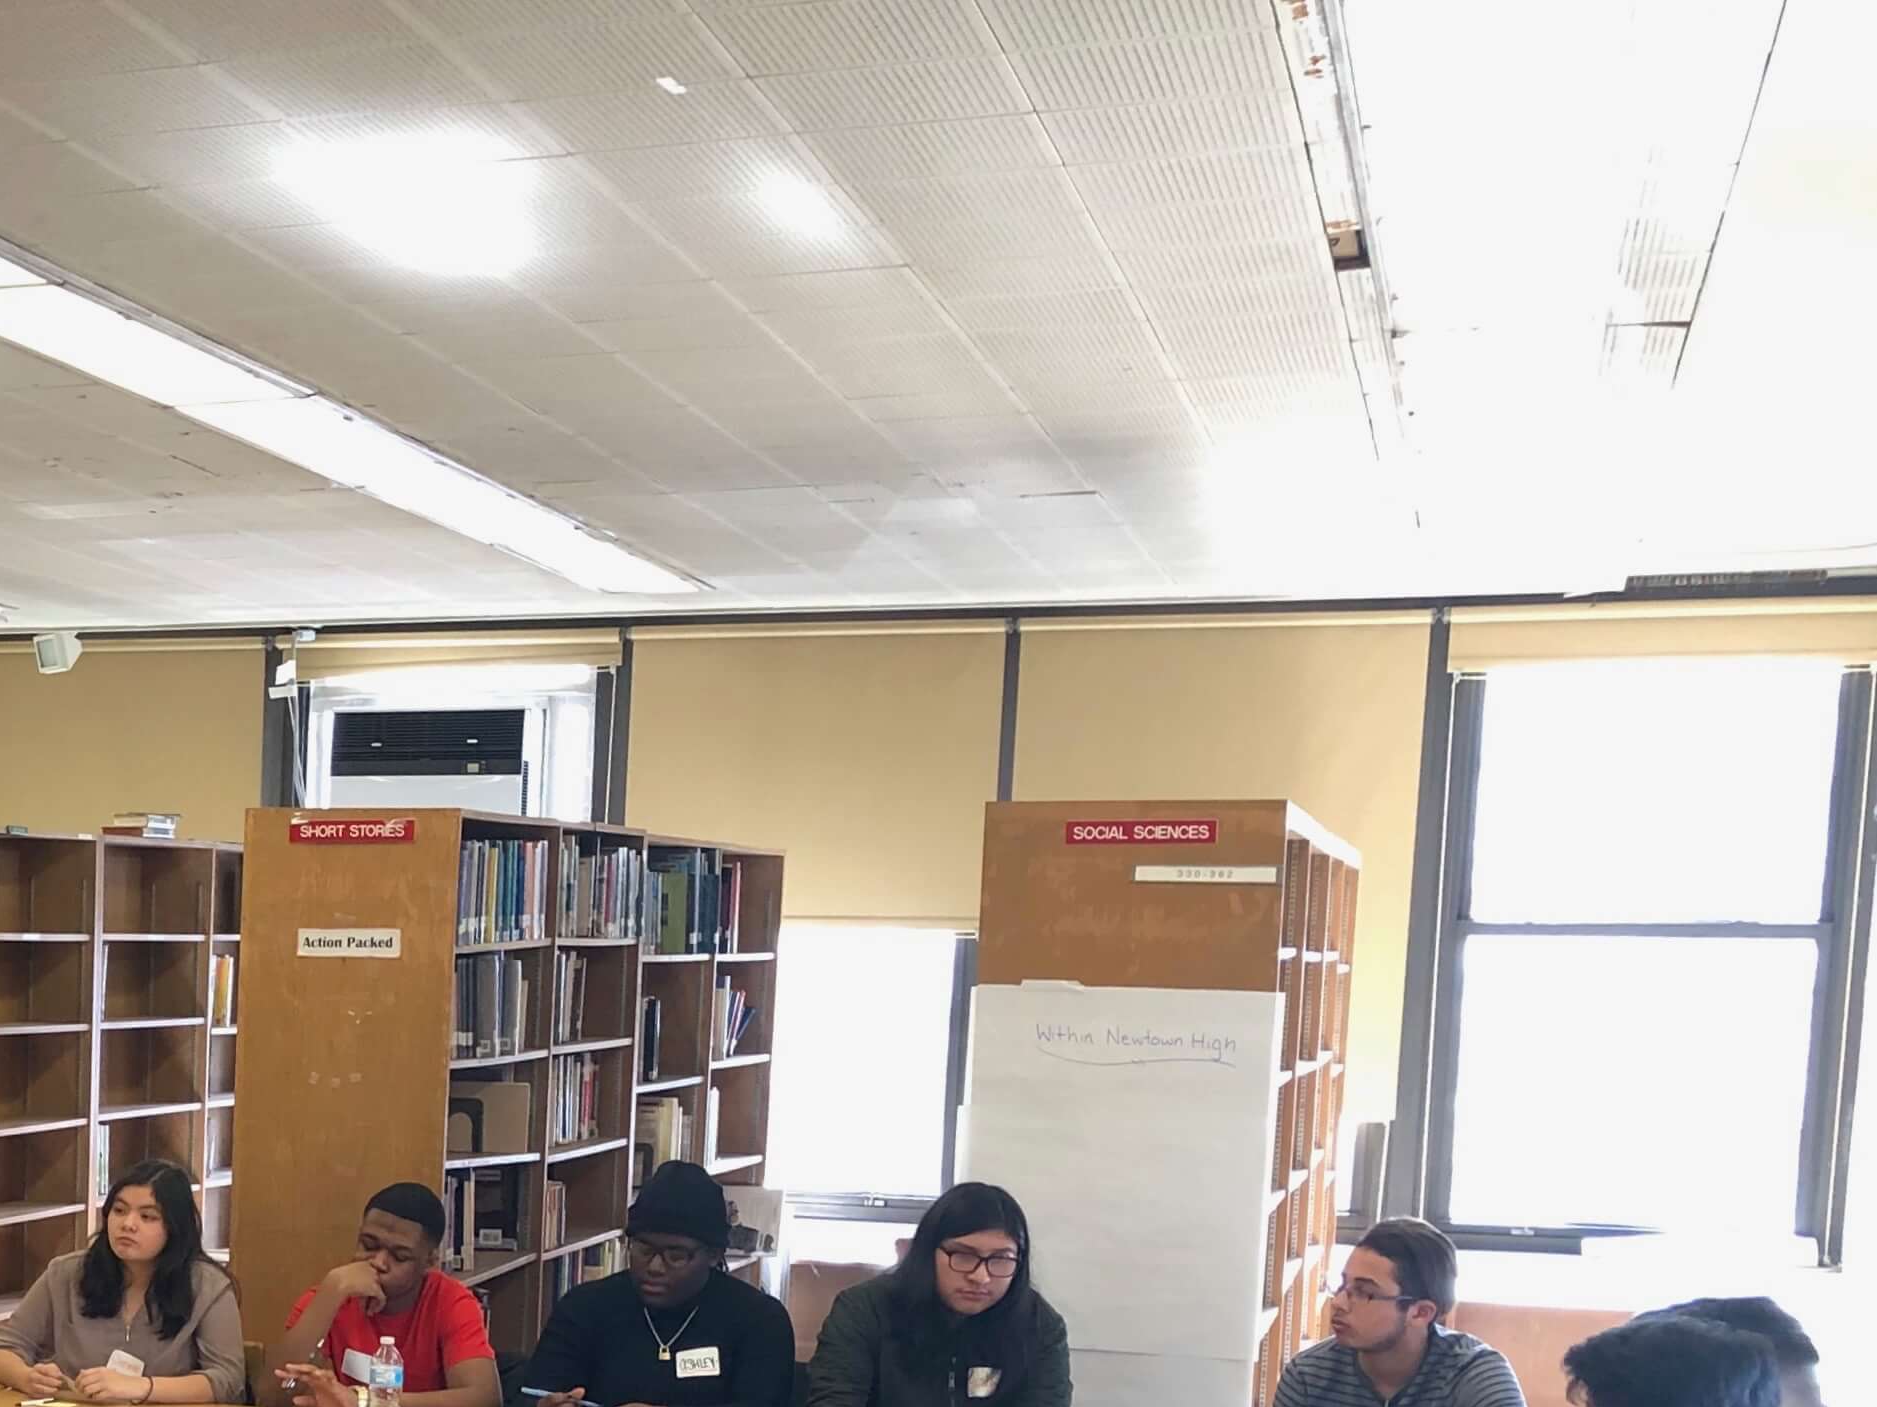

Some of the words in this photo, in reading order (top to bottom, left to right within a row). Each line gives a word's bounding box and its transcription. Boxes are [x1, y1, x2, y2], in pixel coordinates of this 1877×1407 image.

[299, 824, 345, 838] SHORT
[349, 824, 405, 837] STORIES
[1073, 825, 1128, 840] SOCIAL
[1133, 825, 1210, 840] SCIENCES
[302, 936, 342, 949] Action
[347, 936, 393, 949] Packed
[1036, 1023, 1094, 1045] Within
[1106, 1027, 1184, 1047] Newtown
[1191, 1033, 1237, 1062] High
